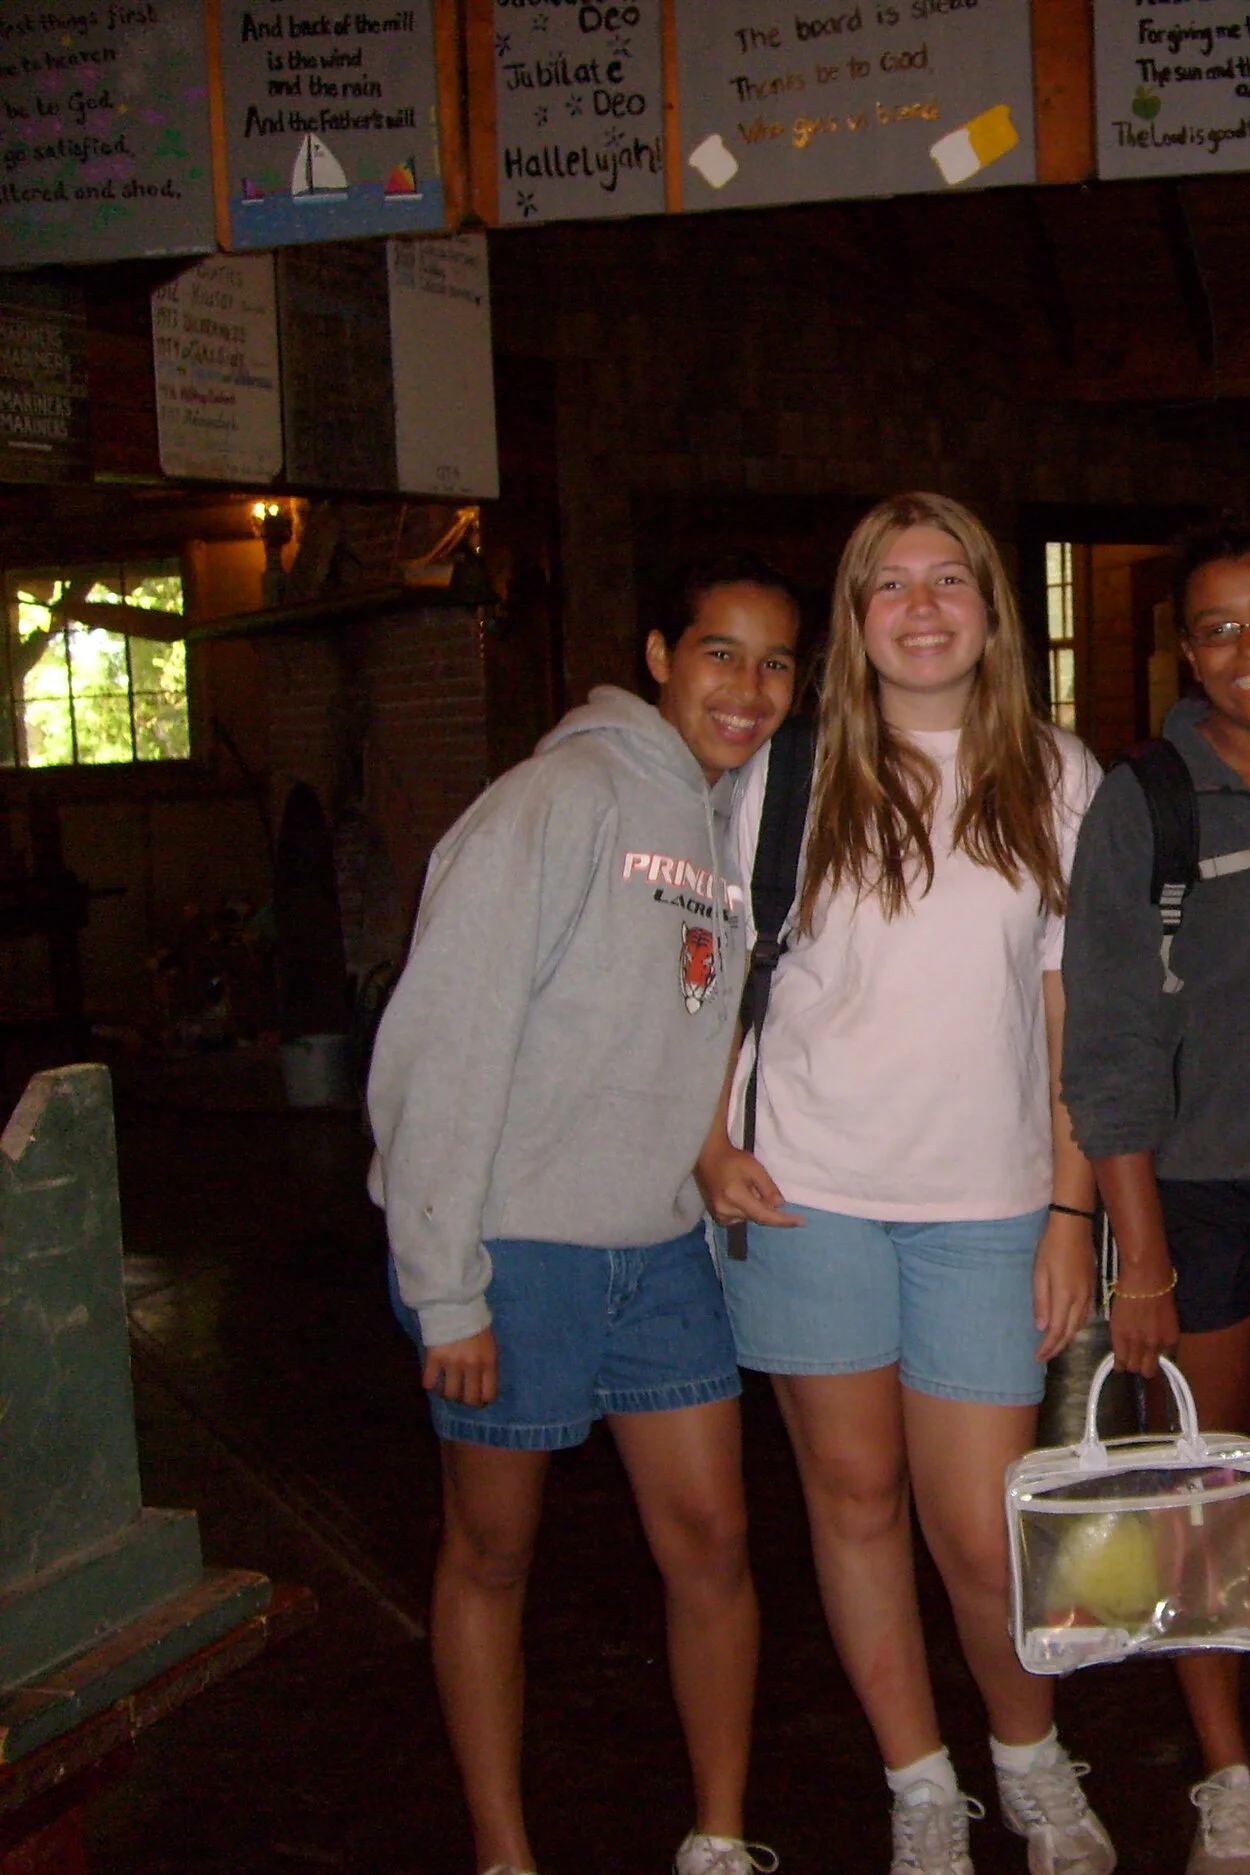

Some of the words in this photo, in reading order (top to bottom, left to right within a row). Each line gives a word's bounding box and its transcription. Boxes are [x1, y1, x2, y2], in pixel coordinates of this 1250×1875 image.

[108, 4, 158, 30] first
[242, 13, 283, 41] And
[290, 15, 332, 38] back
[334, 14, 350, 36] of
[356, 14, 380, 35] the
[383, 11, 415, 32] mill
[579, 6, 641, 33] Deo
[735, 27, 782, 54] The
[795, 6, 863, 41] board
[876, 4, 899, 26] is
[1217, 23, 1240, 39] me
[47, 48, 116, 69] heaven
[268, 51, 283, 70] is
[288, 51, 318, 69] the
[321, 48, 361, 68] wind
[503, 54, 622, 90] Jubilate
[1136, 58, 1170, 87] The
[1175, 65, 1202, 82] sun
[1206, 57, 1235, 80] and
[268, 75, 301, 96] and
[310, 75, 338, 97] the
[343, 74, 381, 97] rain
[730, 75, 806, 102] Thanks
[815, 64, 840, 85] be
[847, 56, 870, 80] to
[594, 90, 645, 117] Deo
[244, 105, 284, 137] And
[290, 111, 318, 131] the
[386, 107, 416, 129] will
[1112, 120, 1149, 148] The
[1190, 126, 1204, 145] is
[1207, 118, 1247, 154] good
[75, 180, 115, 200] and
